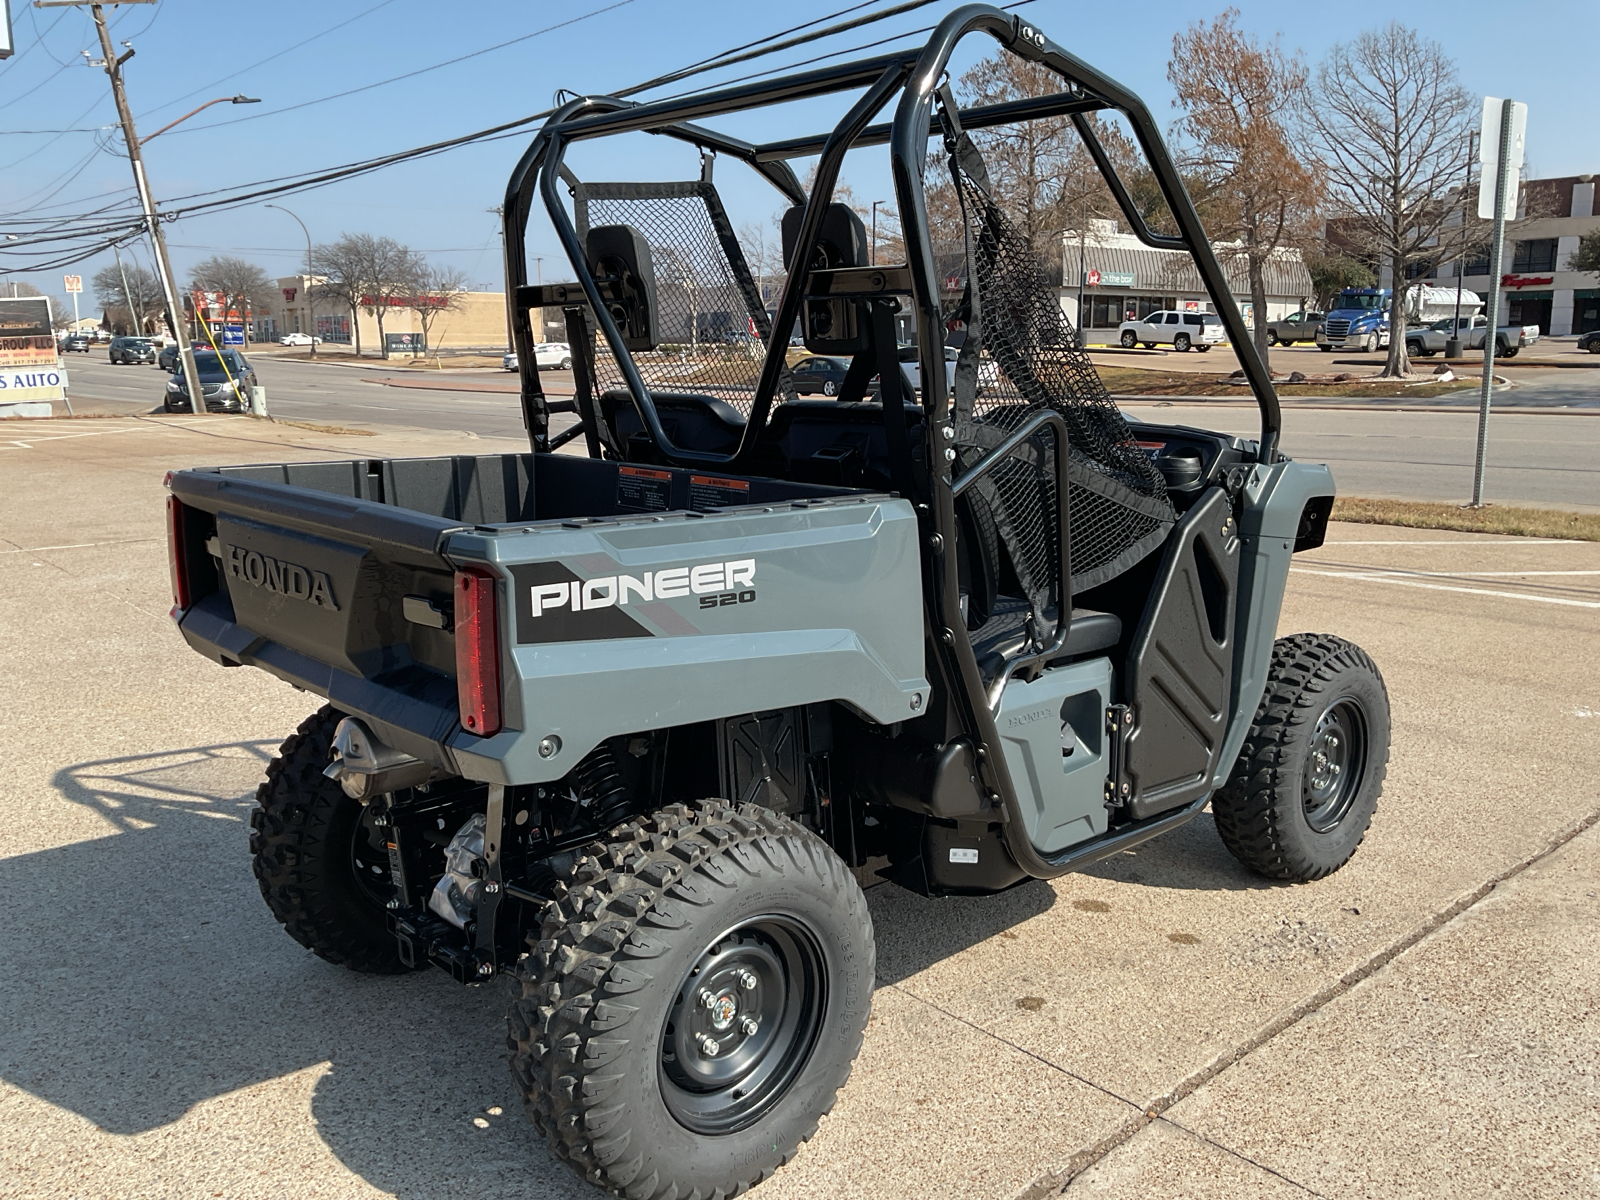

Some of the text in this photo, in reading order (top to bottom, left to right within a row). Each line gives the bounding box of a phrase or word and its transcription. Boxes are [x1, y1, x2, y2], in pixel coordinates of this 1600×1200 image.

[1109, 275, 1120, 283] the
[1121, 275, 1133, 283] box
[34, 338, 53, 349] LLC
[14, 373, 60, 388] AUTO
[226, 543, 341, 611] HONDA
[530, 558, 756, 618] PIONEER
[699, 590, 756, 610] 520
[1007, 708, 1054, 728] HONDA
